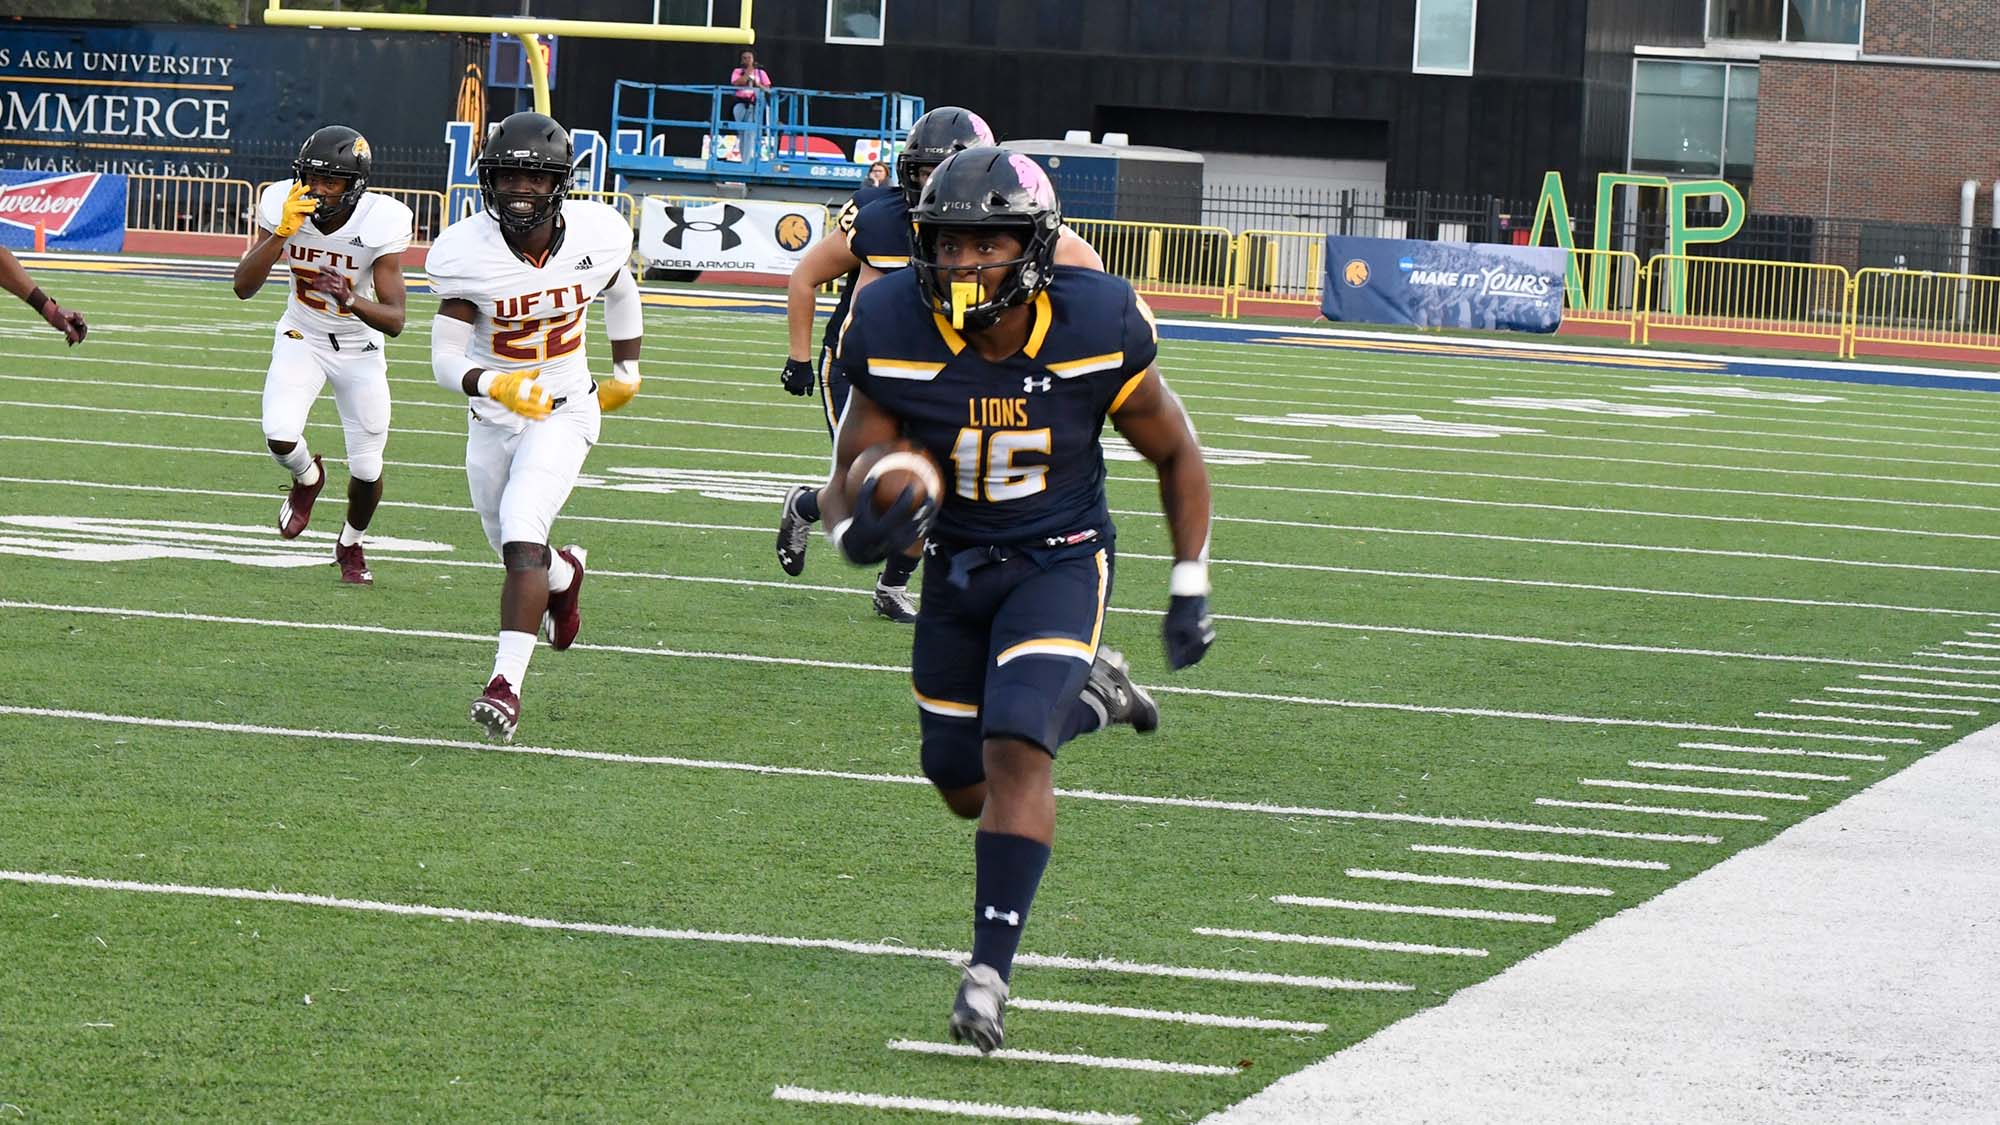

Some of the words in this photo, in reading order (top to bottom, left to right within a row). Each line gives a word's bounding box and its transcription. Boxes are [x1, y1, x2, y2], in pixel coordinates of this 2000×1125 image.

[19, 50, 73, 70] A&M
[83, 52, 233, 77] UNIVERSITY
[0, 91, 231, 139] MMERCE
[0, 184, 81, 213] weiser
[288, 243, 359, 270] UFTL
[697, 260, 755, 269] ARMOUR
[1409, 271, 1459, 287] MAKE
[1461, 273, 1479, 288] IT
[1480, 265, 1551, 296] YOURS
[493, 283, 591, 319] UFTL
[491, 307, 585, 362] 22
[968, 397, 1029, 427] LIONS
[950, 427, 1052, 503] 16
